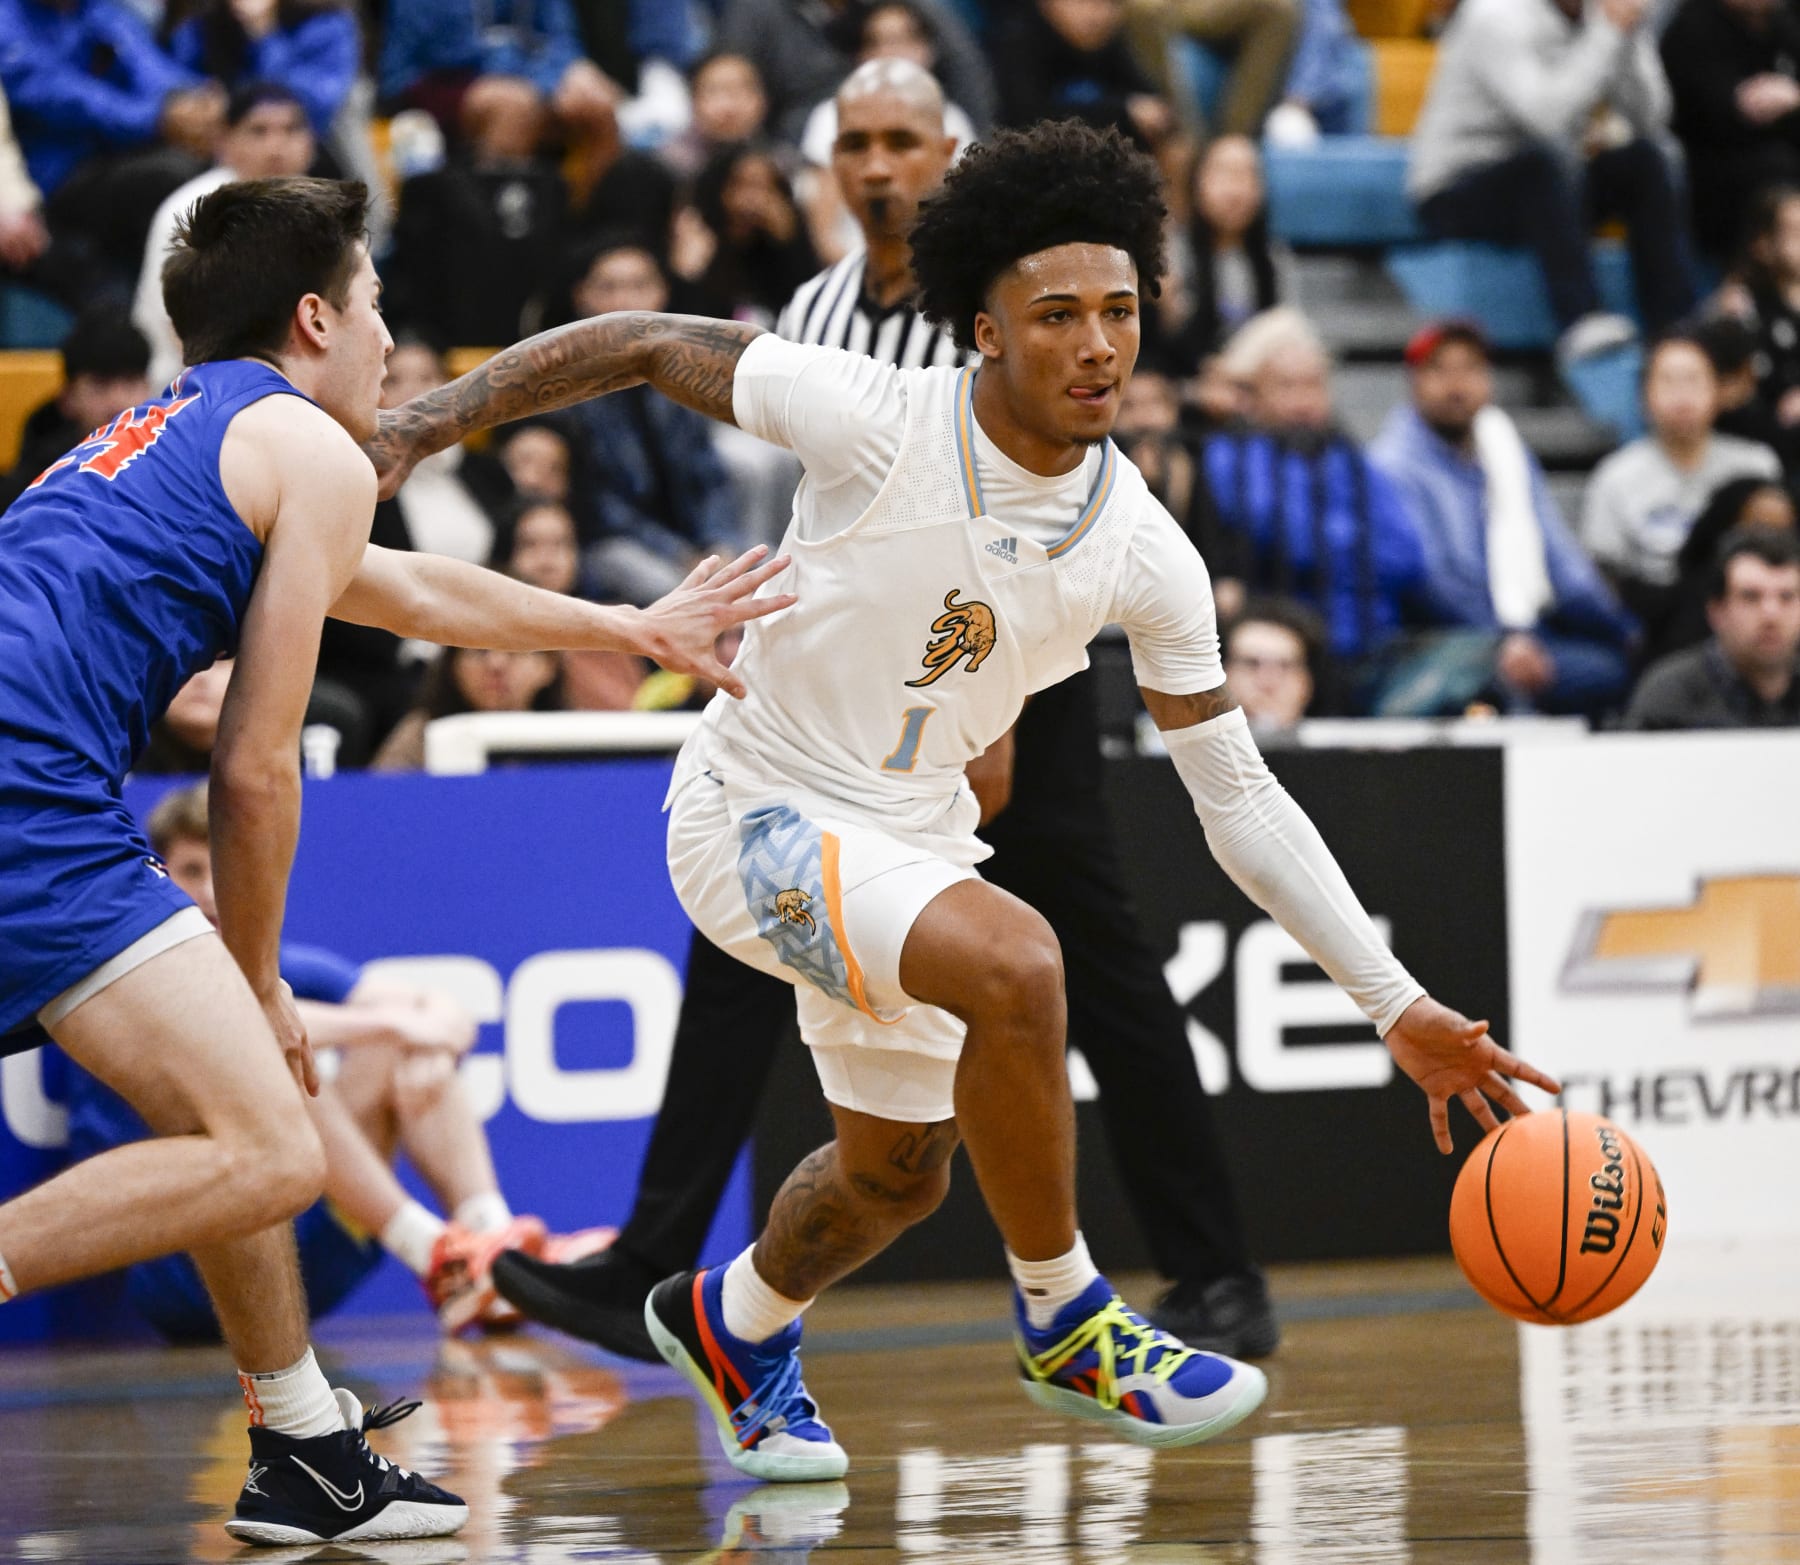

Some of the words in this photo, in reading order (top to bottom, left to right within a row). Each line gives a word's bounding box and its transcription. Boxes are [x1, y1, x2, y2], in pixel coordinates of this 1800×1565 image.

[984, 543, 1018, 565] adidas
[881, 706, 937, 773] 1
[1556, 1065, 1800, 1124] CHEVR
[1580, 1127, 1624, 1256] Wilson
